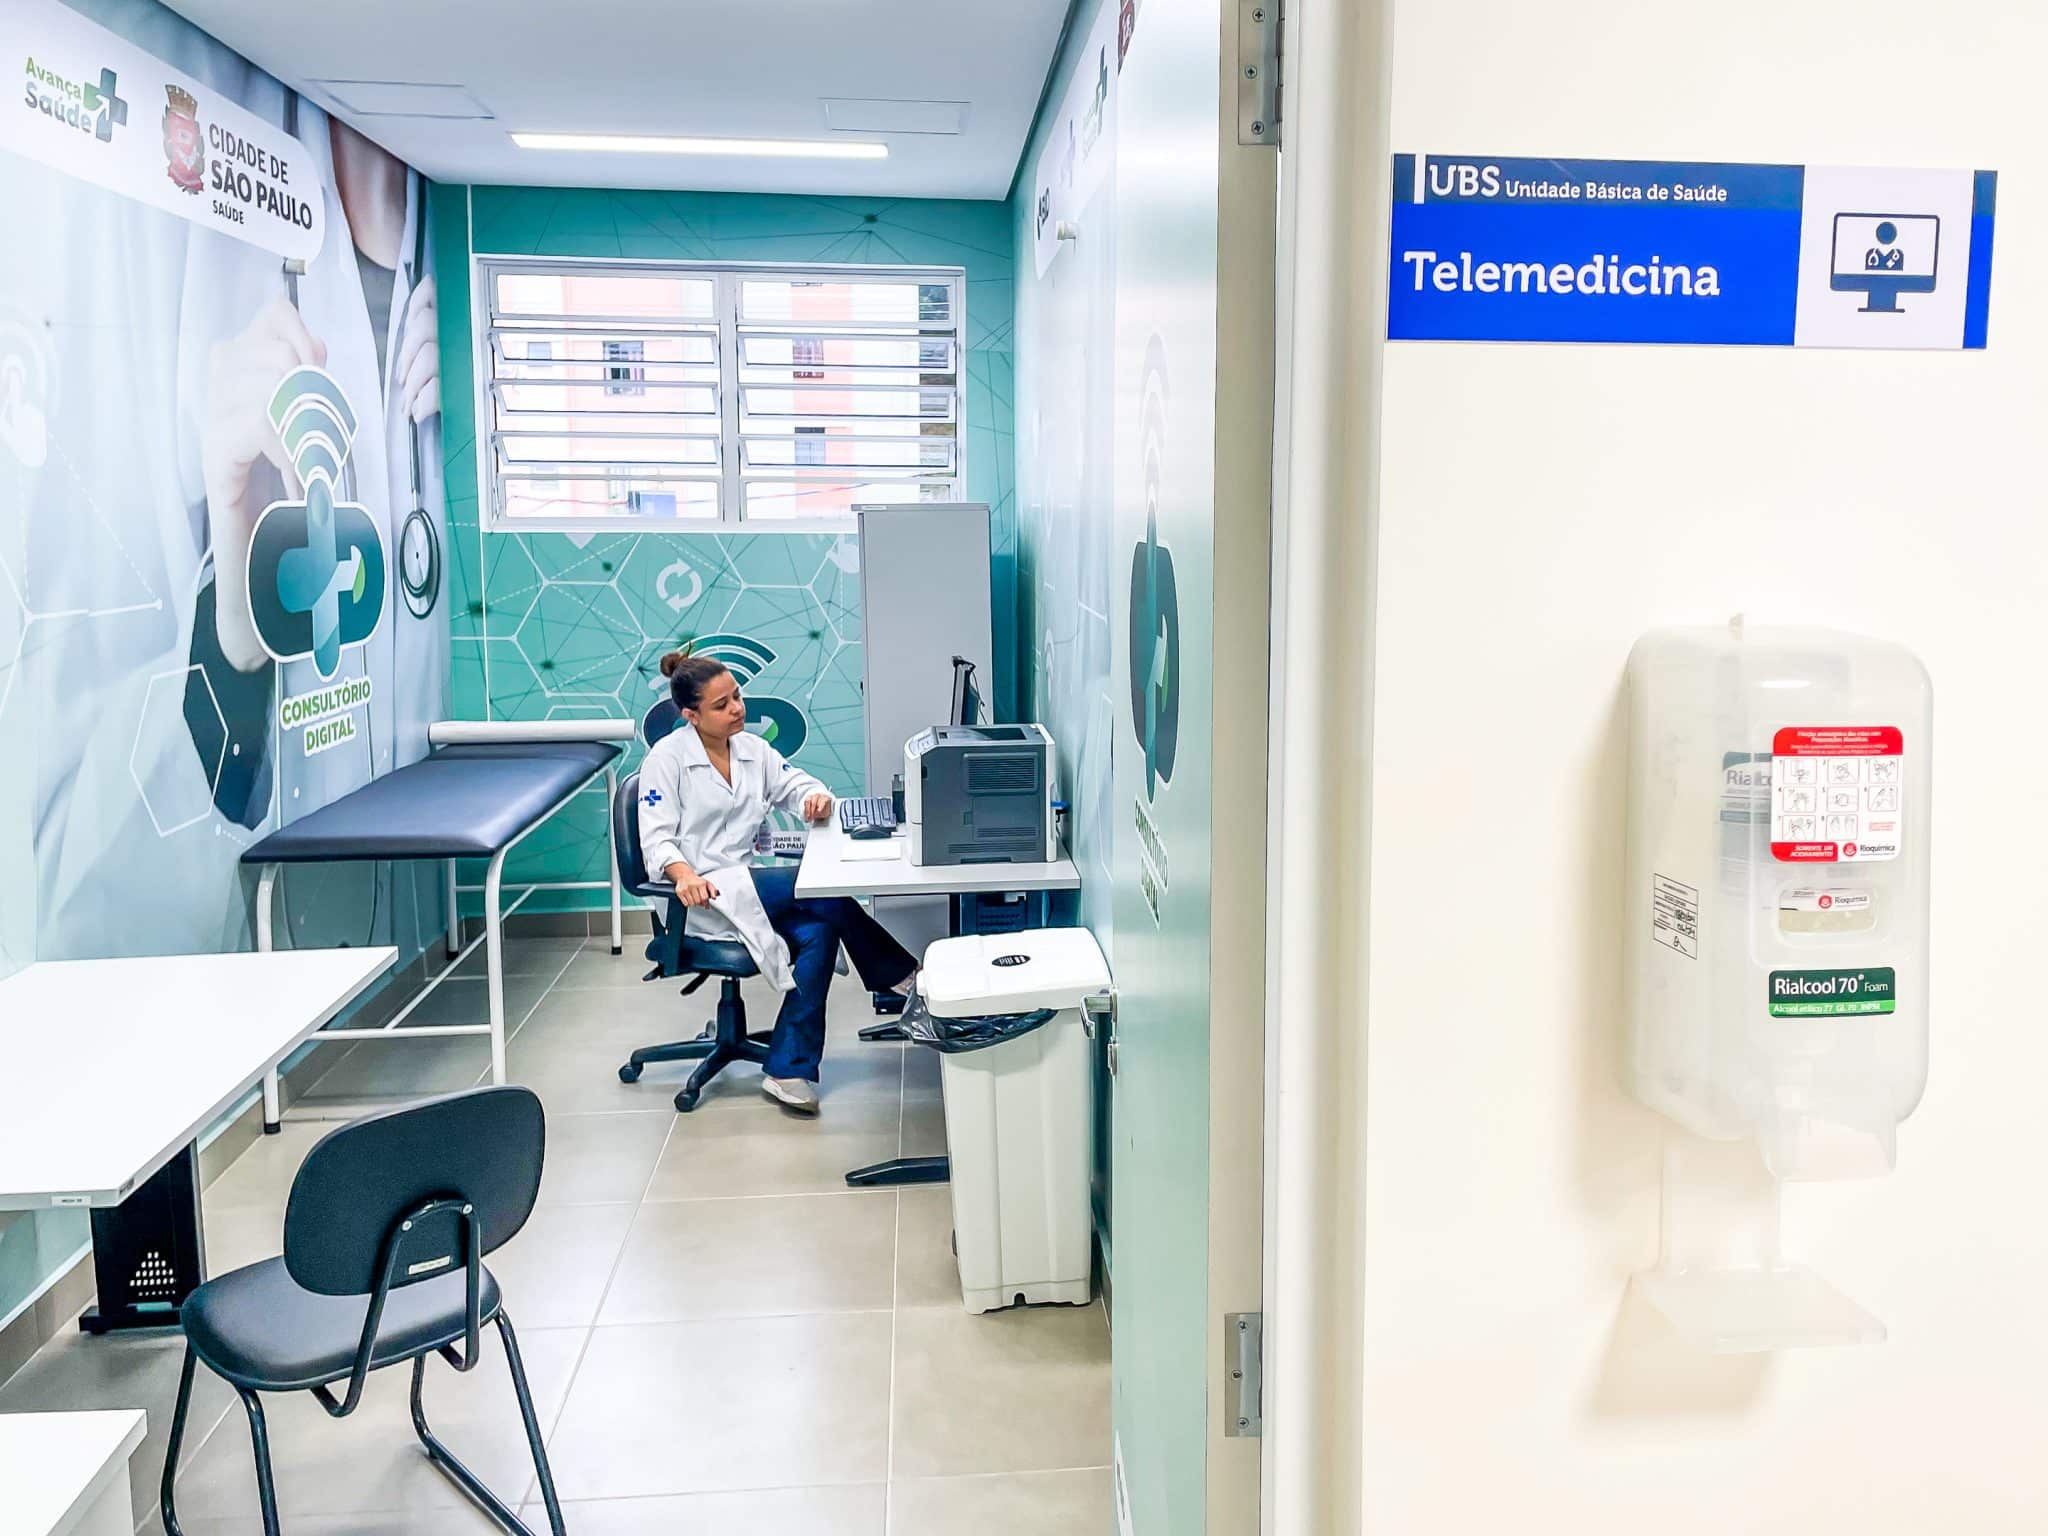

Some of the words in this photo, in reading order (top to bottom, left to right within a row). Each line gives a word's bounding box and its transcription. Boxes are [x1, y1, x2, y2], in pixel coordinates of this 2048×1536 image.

[25, 56, 81, 101] Avança
[24, 81, 92, 133] Saúde
[208, 123, 267, 173] CIDADE
[270, 155, 289, 185] DE
[211, 159, 252, 203] SÃO
[256, 180, 313, 230] PAULO
[1429, 164, 1500, 197] UBS
[1505, 180, 1581, 200] Unidade
[1585, 181, 1642, 201] Básica
[1646, 183, 1668, 201] de
[1673, 183, 1728, 202] Saúde
[212, 199, 245, 225] SAÚDE
[1403, 250, 1721, 297] Telemedicina
[281, 680, 372, 725] CONSULTÓRIO
[305, 716, 354, 752] DIGITAL
[1775, 977, 1836, 995] Rialcool
[1864, 982, 1889, 992] Foam
